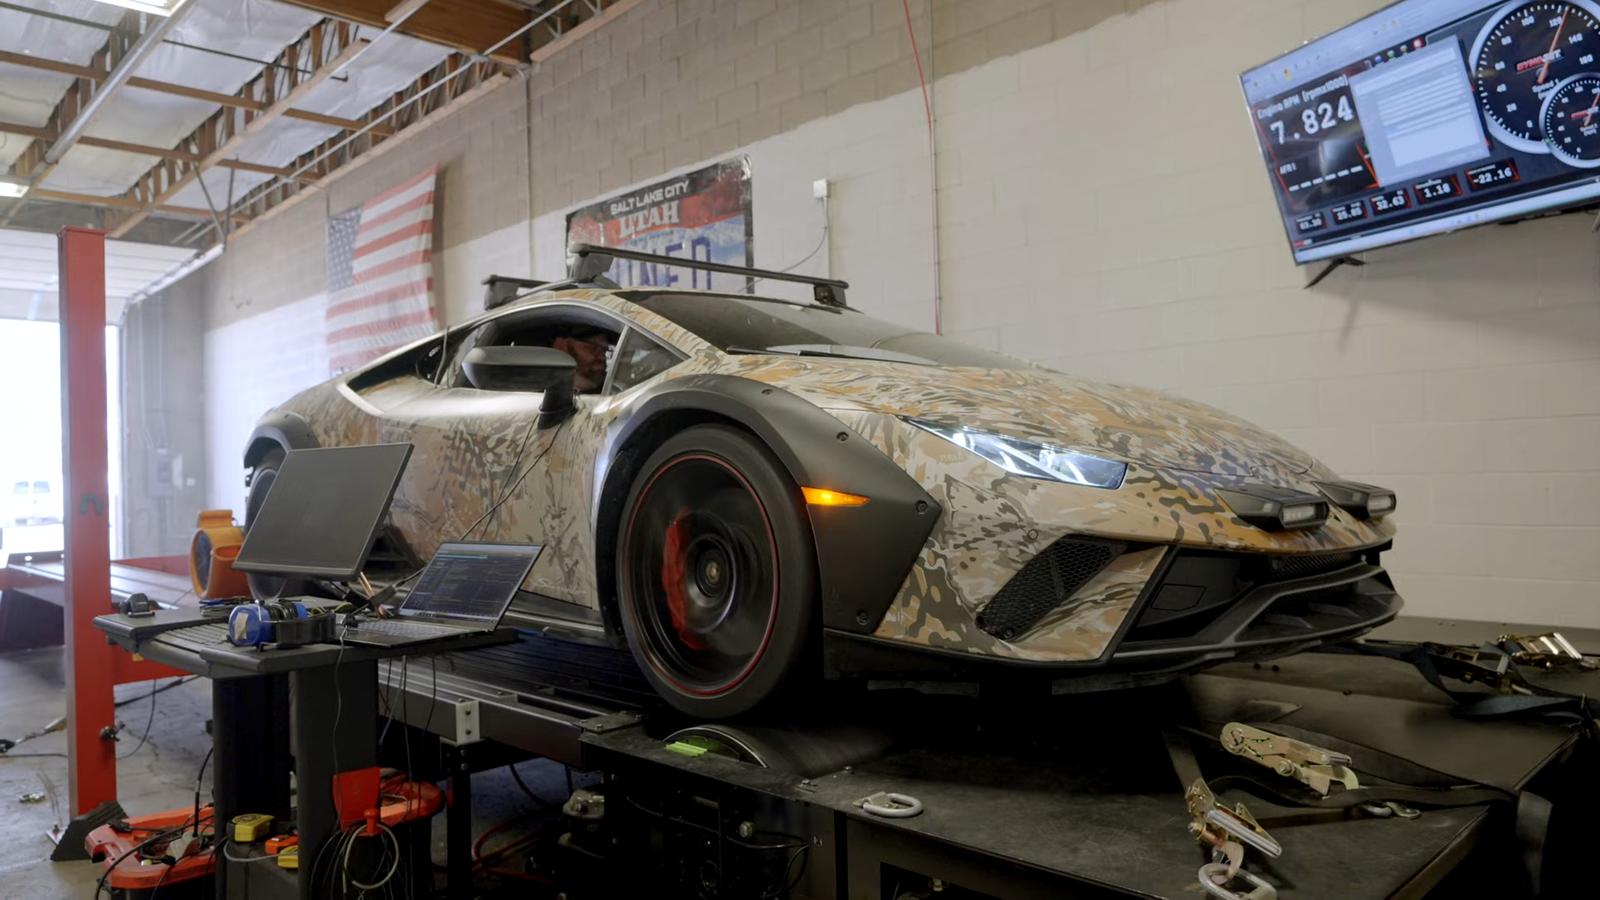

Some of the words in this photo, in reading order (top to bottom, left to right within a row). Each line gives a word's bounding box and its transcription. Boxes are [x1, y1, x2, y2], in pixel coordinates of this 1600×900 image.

[1270, 94, 1354, 145] 7.824
[610, 197, 635, 216] SALT
[636, 188, 664, 208] LAKE
[664, 180, 690, 199] CITY
[618, 200, 680, 239] UTAH
